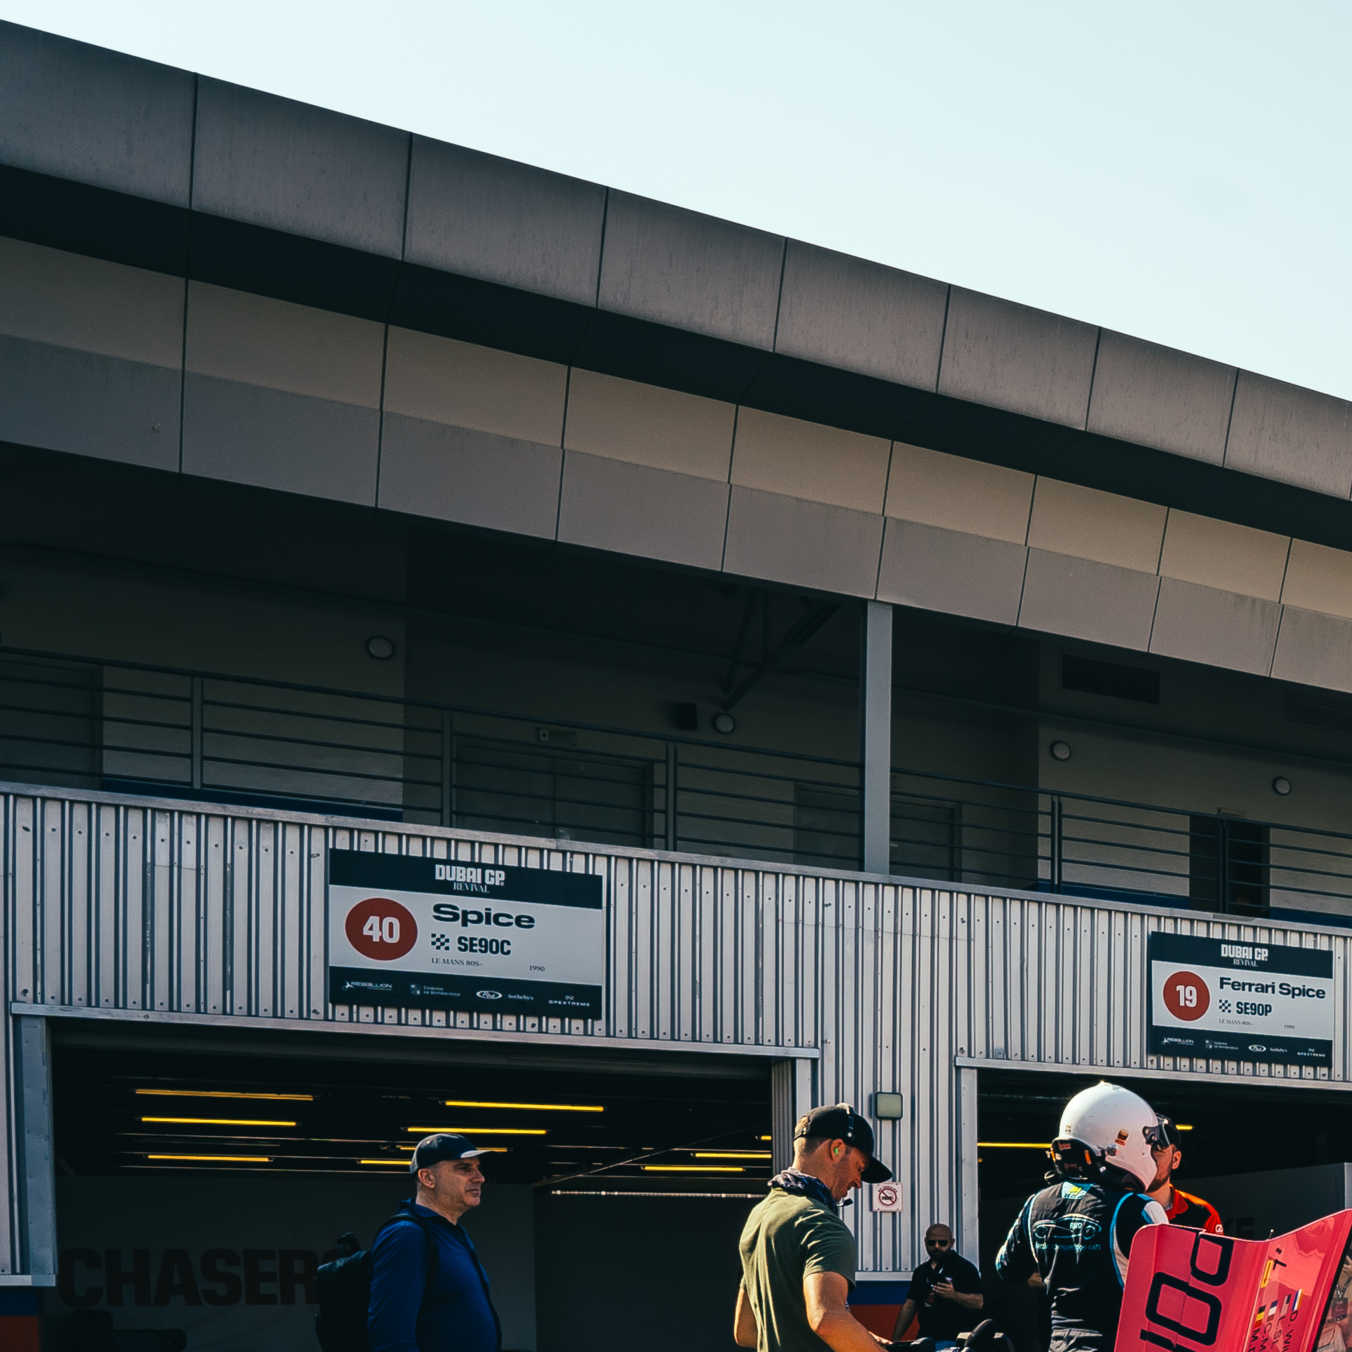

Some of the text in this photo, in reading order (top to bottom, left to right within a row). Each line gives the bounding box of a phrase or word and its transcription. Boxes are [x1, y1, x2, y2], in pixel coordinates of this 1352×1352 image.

[435, 864, 483, 885] DUBAI
[453, 883, 490, 894] REVIVAL
[432, 903, 536, 929] Spice
[362, 915, 400, 944] 40
[457, 936, 512, 956] SE90C
[1221, 944, 1253, 960] DUBAI
[1176, 984, 1198, 1008] 19
[1219, 976, 1326, 999] Ferrari Spice
[1236, 1002, 1272, 1017] SE90P
